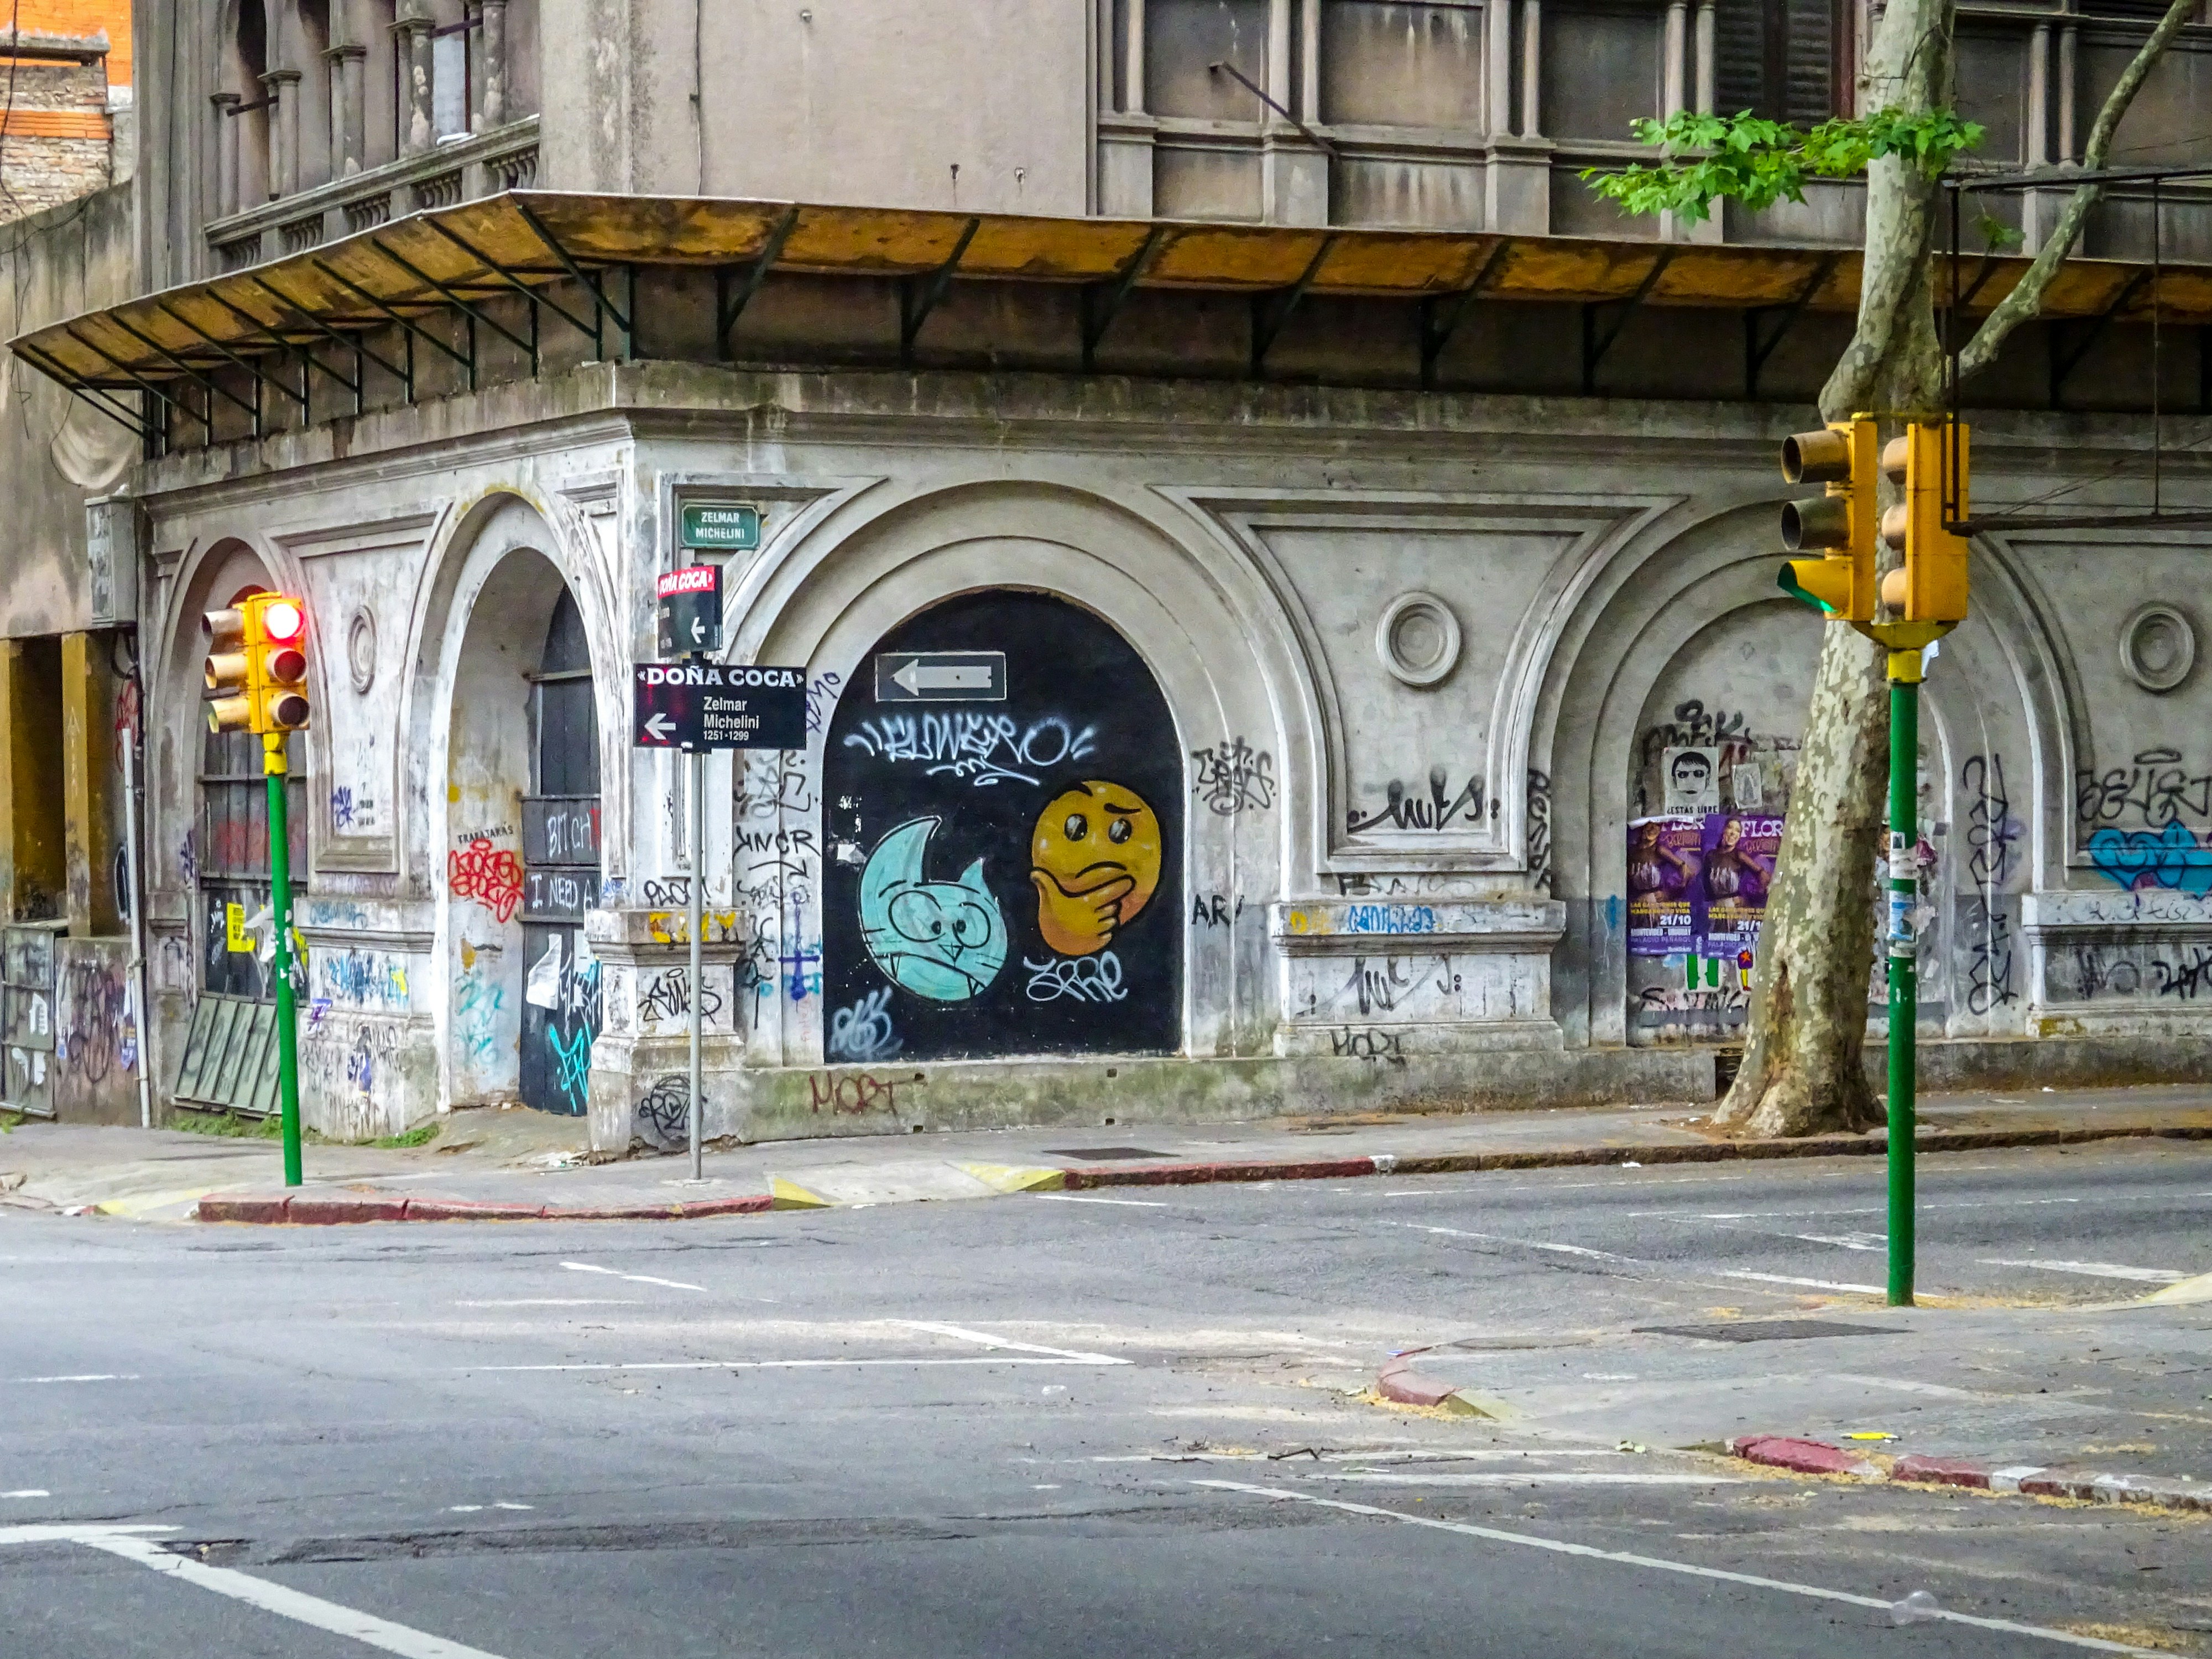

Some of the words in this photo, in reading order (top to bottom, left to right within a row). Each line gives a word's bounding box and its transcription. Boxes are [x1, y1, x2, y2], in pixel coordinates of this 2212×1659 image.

[701, 512, 740, 523] ZELMAR
[695, 527, 745, 539] MICHELINI
[703, 696, 748, 711] Zelmar
[703, 713, 760, 729] Michelini
[547, 812, 592, 857] BITCH
[1740, 820, 1784, 837] FLOR
[549, 876, 579, 912] NEED
[1660, 914, 1692, 925] 21/10
